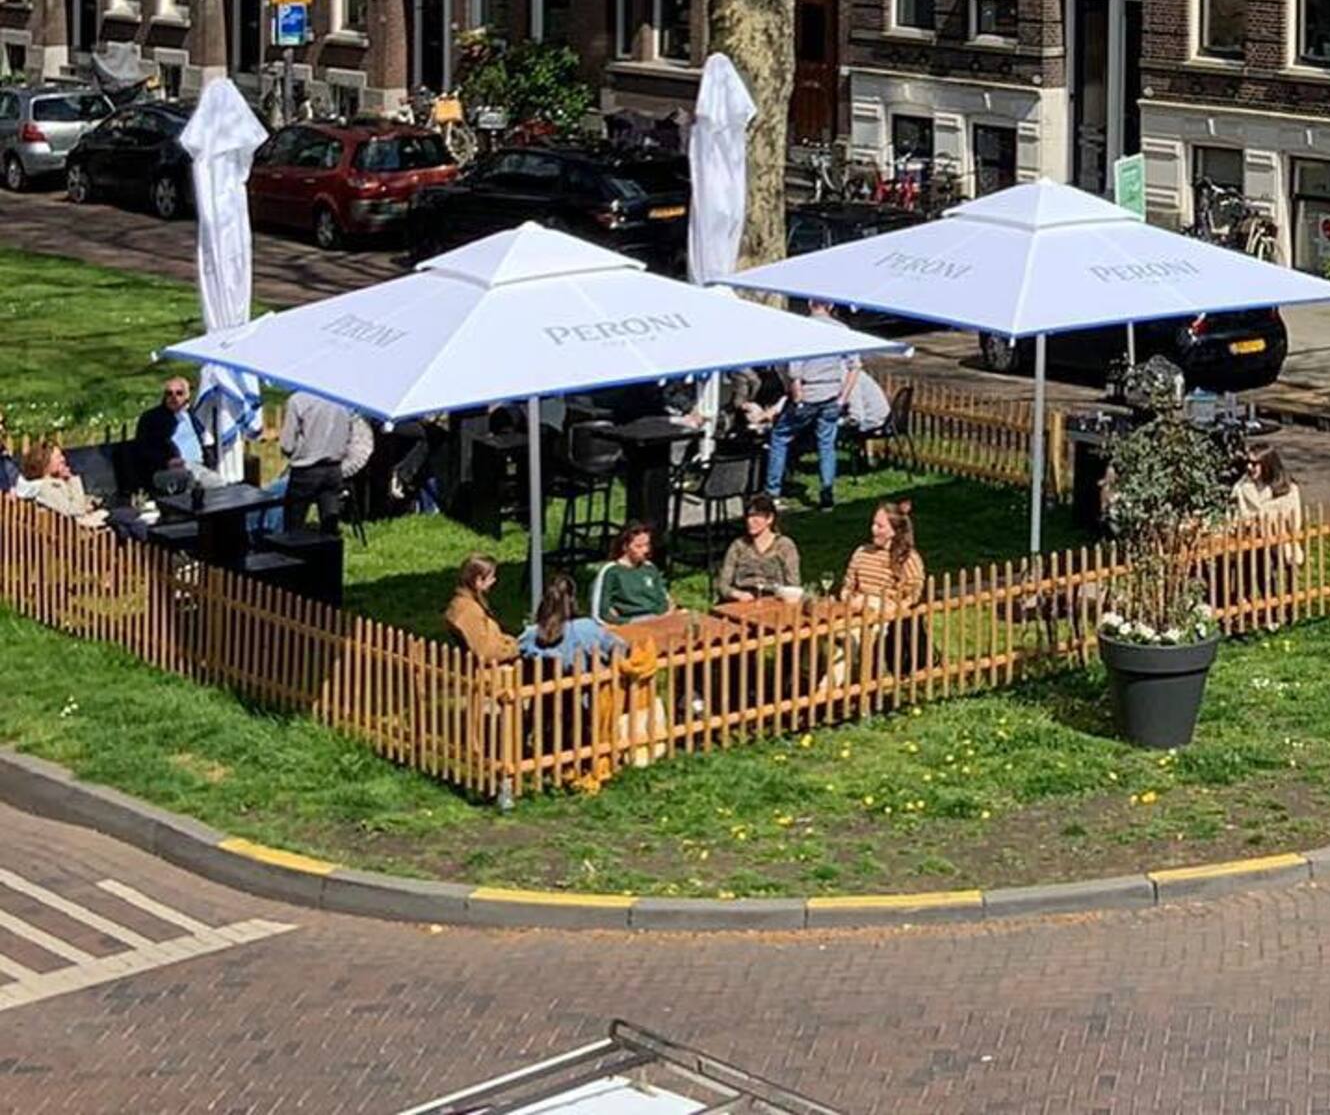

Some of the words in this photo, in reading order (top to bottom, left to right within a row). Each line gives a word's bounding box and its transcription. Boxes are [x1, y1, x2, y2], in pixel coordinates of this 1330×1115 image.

[875, 251, 973, 280] PERONI
[1089, 259, 1200, 283] PERONI
[320, 312, 409, 348] PERONI
[543, 312, 692, 346] PERONI
